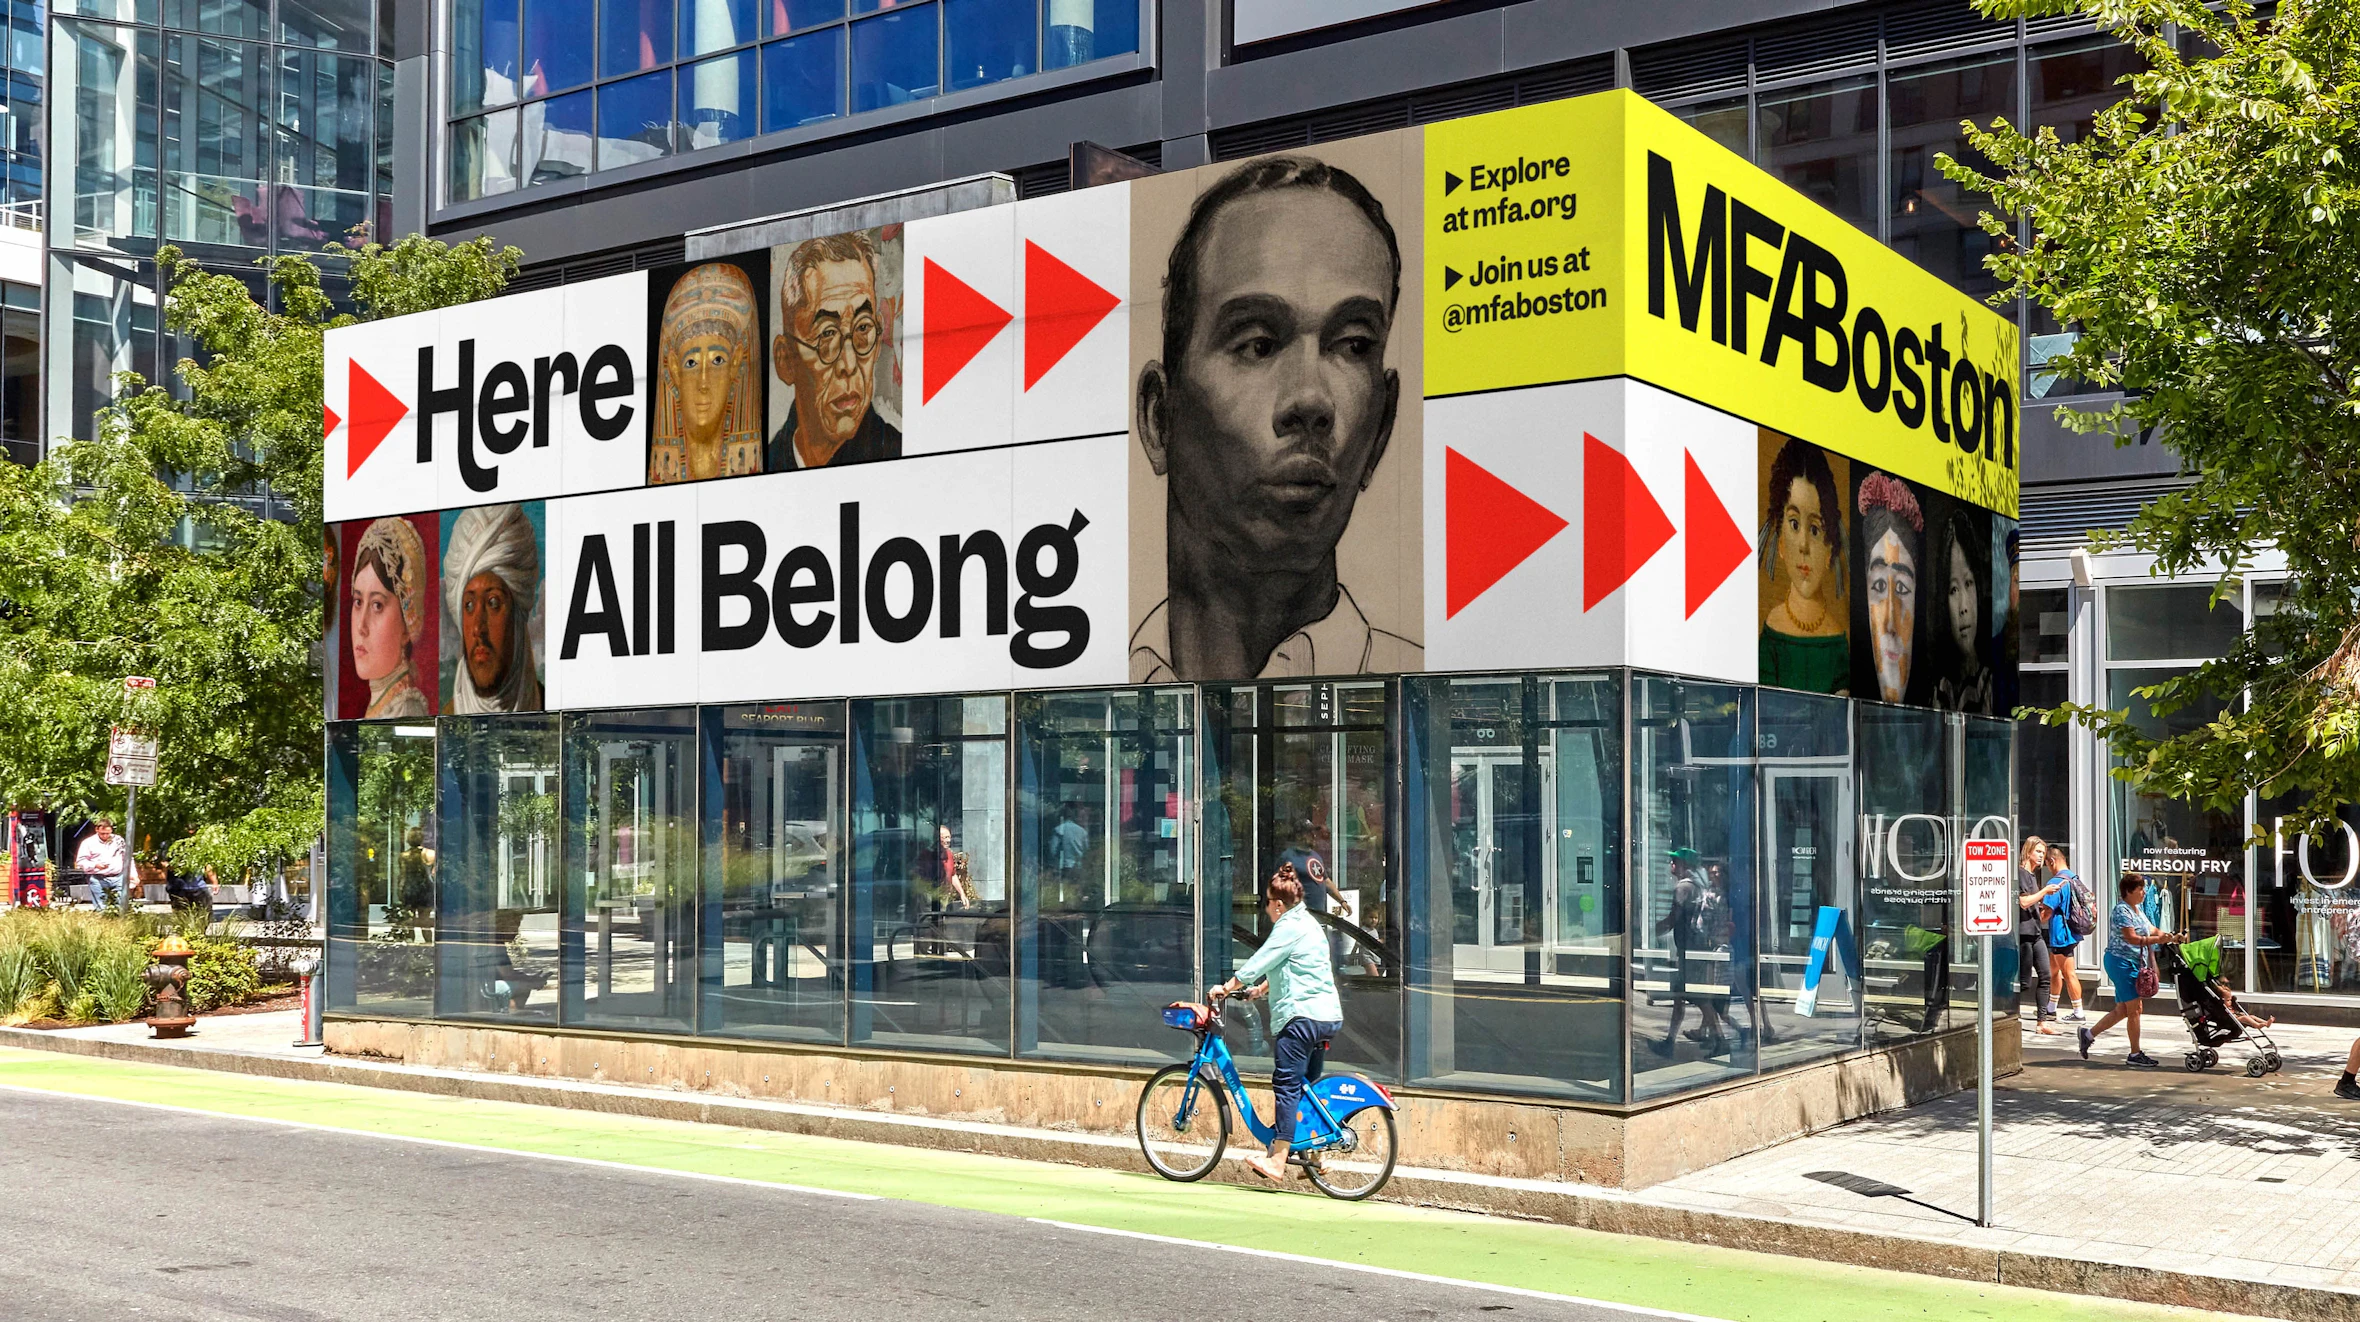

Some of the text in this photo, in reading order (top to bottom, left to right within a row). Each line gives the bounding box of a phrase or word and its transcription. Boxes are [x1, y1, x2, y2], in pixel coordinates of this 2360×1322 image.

[1470, 156, 1571, 192] Explore
[1443, 193, 1577, 233] at mfa.org
[1469, 246, 1590, 287] Join us at
[1443, 287, 1607, 333] @mfaboston
[416, 338, 635, 493] Here
[559, 501, 1091, 669] All Belong
[1967, 845, 2006, 856] TOW ZONE
[2163, 847, 2206, 857] featuring
[1982, 863, 1993, 872] NO
[2121, 858, 2232, 873] EMERSON FRY
[1969, 876, 2006, 886] STOPPING
[1979, 890, 1996, 899] ANY
[2289, 896, 2320, 905] invest
[2321, 896, 2331, 905] in
[1979, 904, 1996, 913] TIME
